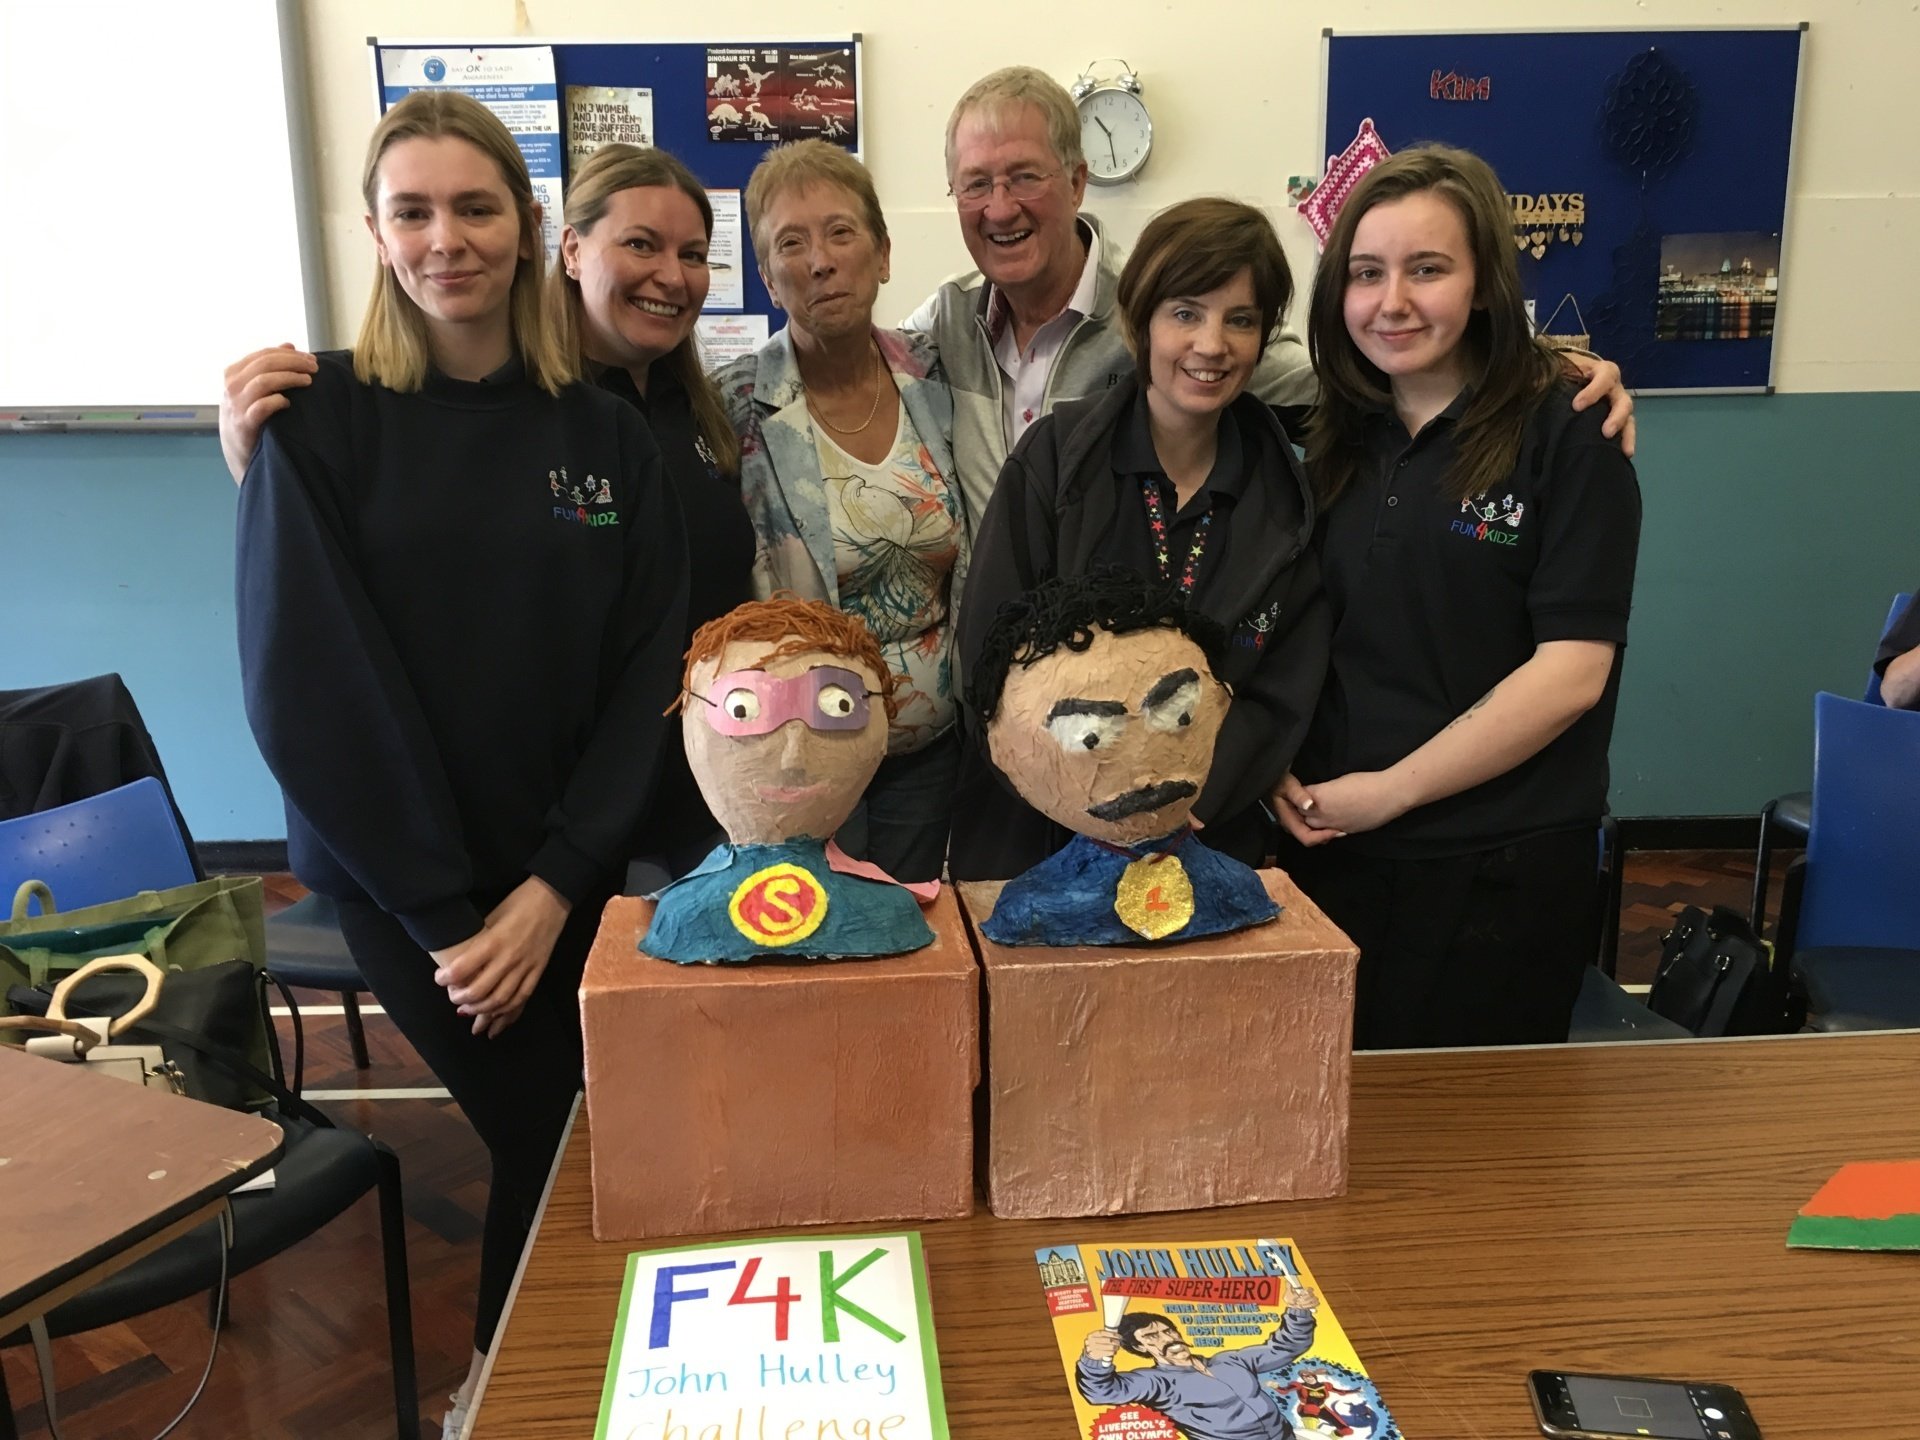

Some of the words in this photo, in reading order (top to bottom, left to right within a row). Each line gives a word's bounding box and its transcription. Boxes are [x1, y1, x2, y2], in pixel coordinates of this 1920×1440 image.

[466, 64, 480, 73] OK
[1090, 102, 1098, 110] 11
[1104, 97, 1114, 106] 12
[577, 104, 587, 112] IN
[589, 104, 594, 112] 3
[573, 113, 592, 122] AND
[600, 114, 608, 122] IN
[610, 114, 615, 123] 6
[617, 115, 636, 124] MEN
[1135, 112, 1140, 121] 2
[573, 123, 596, 132] HAVE
[599, 123, 641, 133] SUFFERED
[573, 132, 616, 142] DOMESTIC
[618, 134, 649, 143] ABUSE.
[1140, 130, 1145, 138] 3
[1134, 147, 1139, 155] 4
[1092, 160, 1097, 168] 7
[1106, 164, 1112, 172] 6
[1123, 159, 1128, 167] 5
[1450, 520, 1519, 546] FUN4KIDZ
[758, 878, 804, 933] S
[1095, 1250, 1180, 1280] JOHN
[1178, 1245, 1301, 1279] HULLEY
[1105, 1279, 1123, 1293] THE
[1126, 1279, 1162, 1295] FIRST
[1166, 1280, 1272, 1301] SUPER-HERO
[649, 1248, 907, 1350] F4K
[1163, 1304, 1196, 1313] TRAVEL
[1197, 1304, 1222, 1313] BACK
[1224, 1304, 1235, 1313] IN
[1236, 1304, 1260, 1312] TIME
[1179, 1315, 1193, 1324] TO
[1194, 1315, 1220, 1324] MEET
[1220, 1313, 1280, 1324] LIVERPOOL'S
[1186, 1326, 1214, 1335] MOST
[1216, 1326, 1262, 1335] AMAZING
[1193, 1337, 1225, 1347] HERO!
[629, 1363, 728, 1398] John
[760, 1354, 896, 1396] Hulley
[1120, 1411, 1139, 1421] SEE
[1098, 1420, 1167, 1433] LIVERPOOL'S
[1097, 1432, 1123, 1440] OWN
[1126, 1430, 1173, 1440] OLYMPIC
